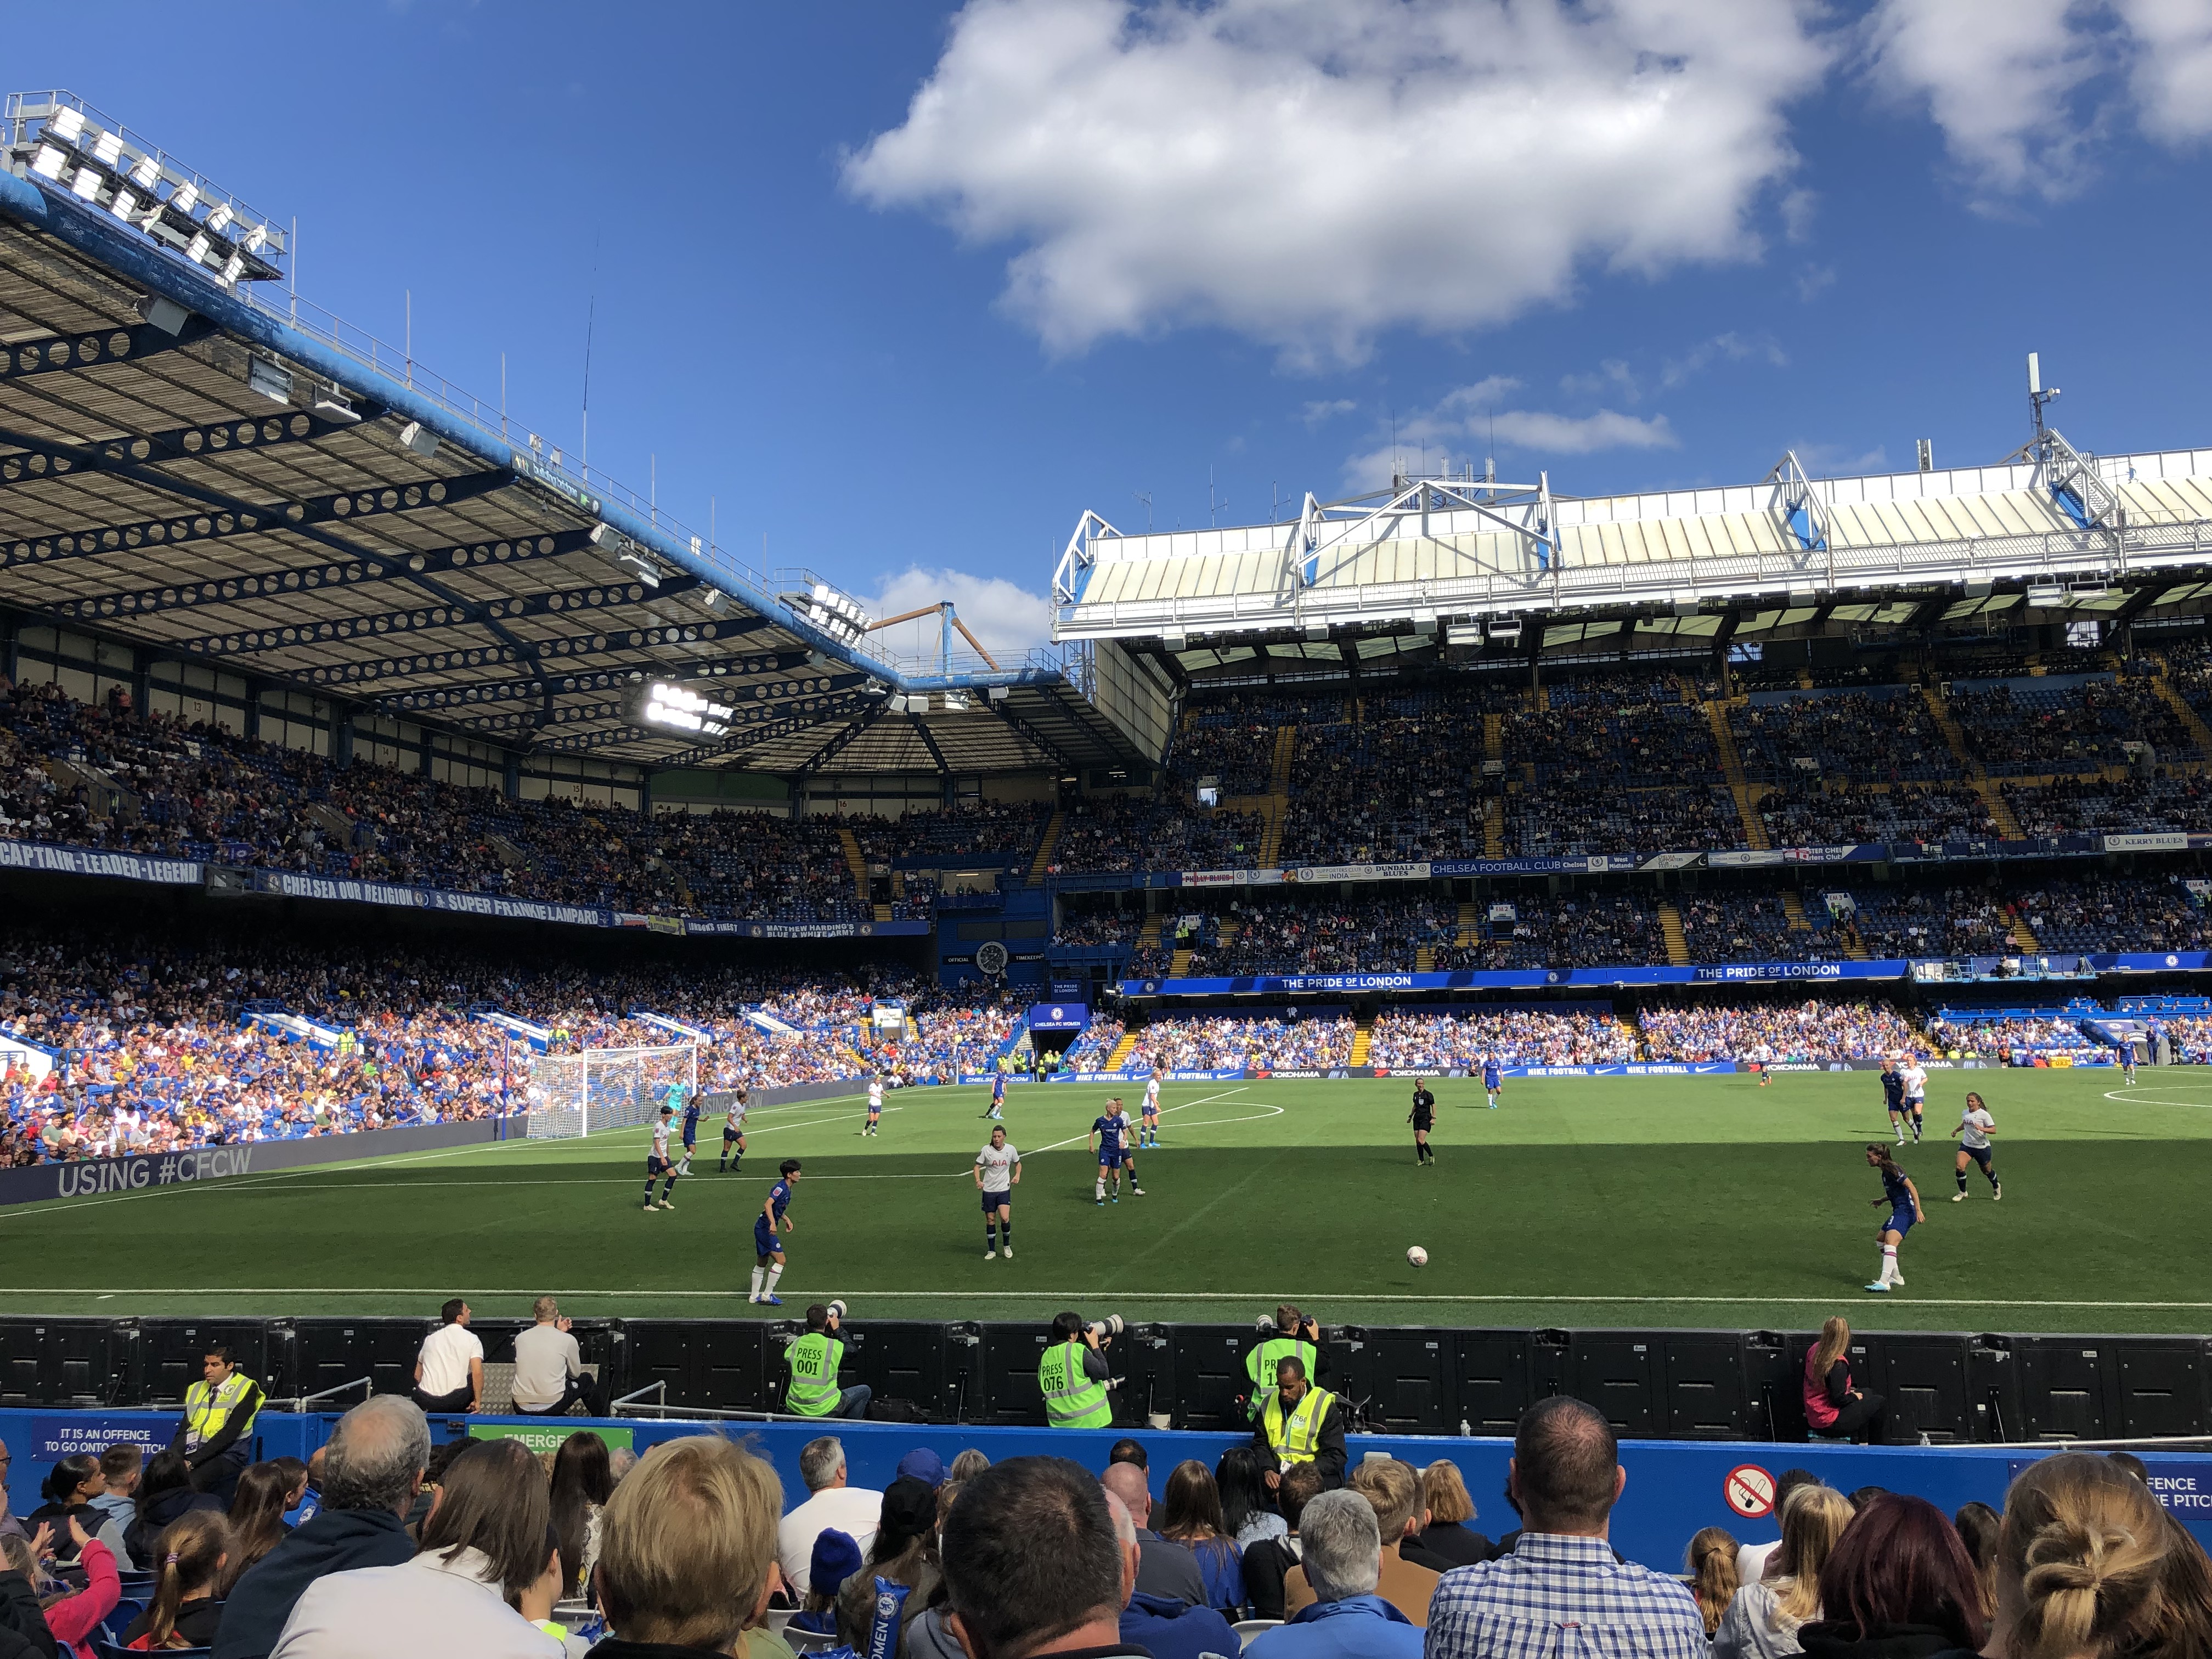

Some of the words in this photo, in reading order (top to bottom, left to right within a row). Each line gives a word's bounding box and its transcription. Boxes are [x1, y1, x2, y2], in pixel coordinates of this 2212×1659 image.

[194, 701, 201, 712] 13
[382, 747, 389, 756] 14
[1432, 864, 1477, 873] CHELSEA
[1480, 862, 1531, 872] FOOTBALL
[1534, 861, 1561, 870] CLUB
[1185, 874, 1207, 883] PHILLY
[283, 874, 337, 899] CHELSEA
[338, 881, 362, 900] OUR
[365, 884, 414, 906] RELIGION
[448, 894, 492, 915] SUPER
[493, 899, 546, 919] FRANKIE
[548, 906, 598, 924] LAMPARD
[716, 923, 738, 932] FINEST
[809, 923, 854, 932] HARDING'S
[1698, 968, 1723, 978] THE
[1726, 967, 1765, 977] PRIDE
[1784, 964, 1840, 976] LONDON
[1282, 979, 1304, 988] THE
[1307, 978, 1343, 988] PRIDE
[1360, 976, 1411, 986] LONDON
[1549, 1067, 1589, 1075] FOOTBALL
[1648, 1065, 1689, 1074] FOOTBALL
[700, 1096, 729, 1115] USING
[59, 1159, 149, 1197] USING
[159, 1147, 252, 1184] #CFCW
[797, 1347, 822, 1360] PRESS
[797, 1359, 818, 1375] 001
[1042, 1363, 1063, 1376] PRESS
[1043, 1376, 1064, 1391] 076
[60, 1429, 71, 1438] IT
[73, 1429, 83, 1439] IS
[85, 1429, 100, 1439] AN
[103, 1430, 151, 1440] OFFENCE
[45, 1441, 59, 1452] TO
[61, 1442, 77, 1452] GO
[80, 1442, 109, 1452] ONTO
[2174, 1494, 2212, 1508] PITC
